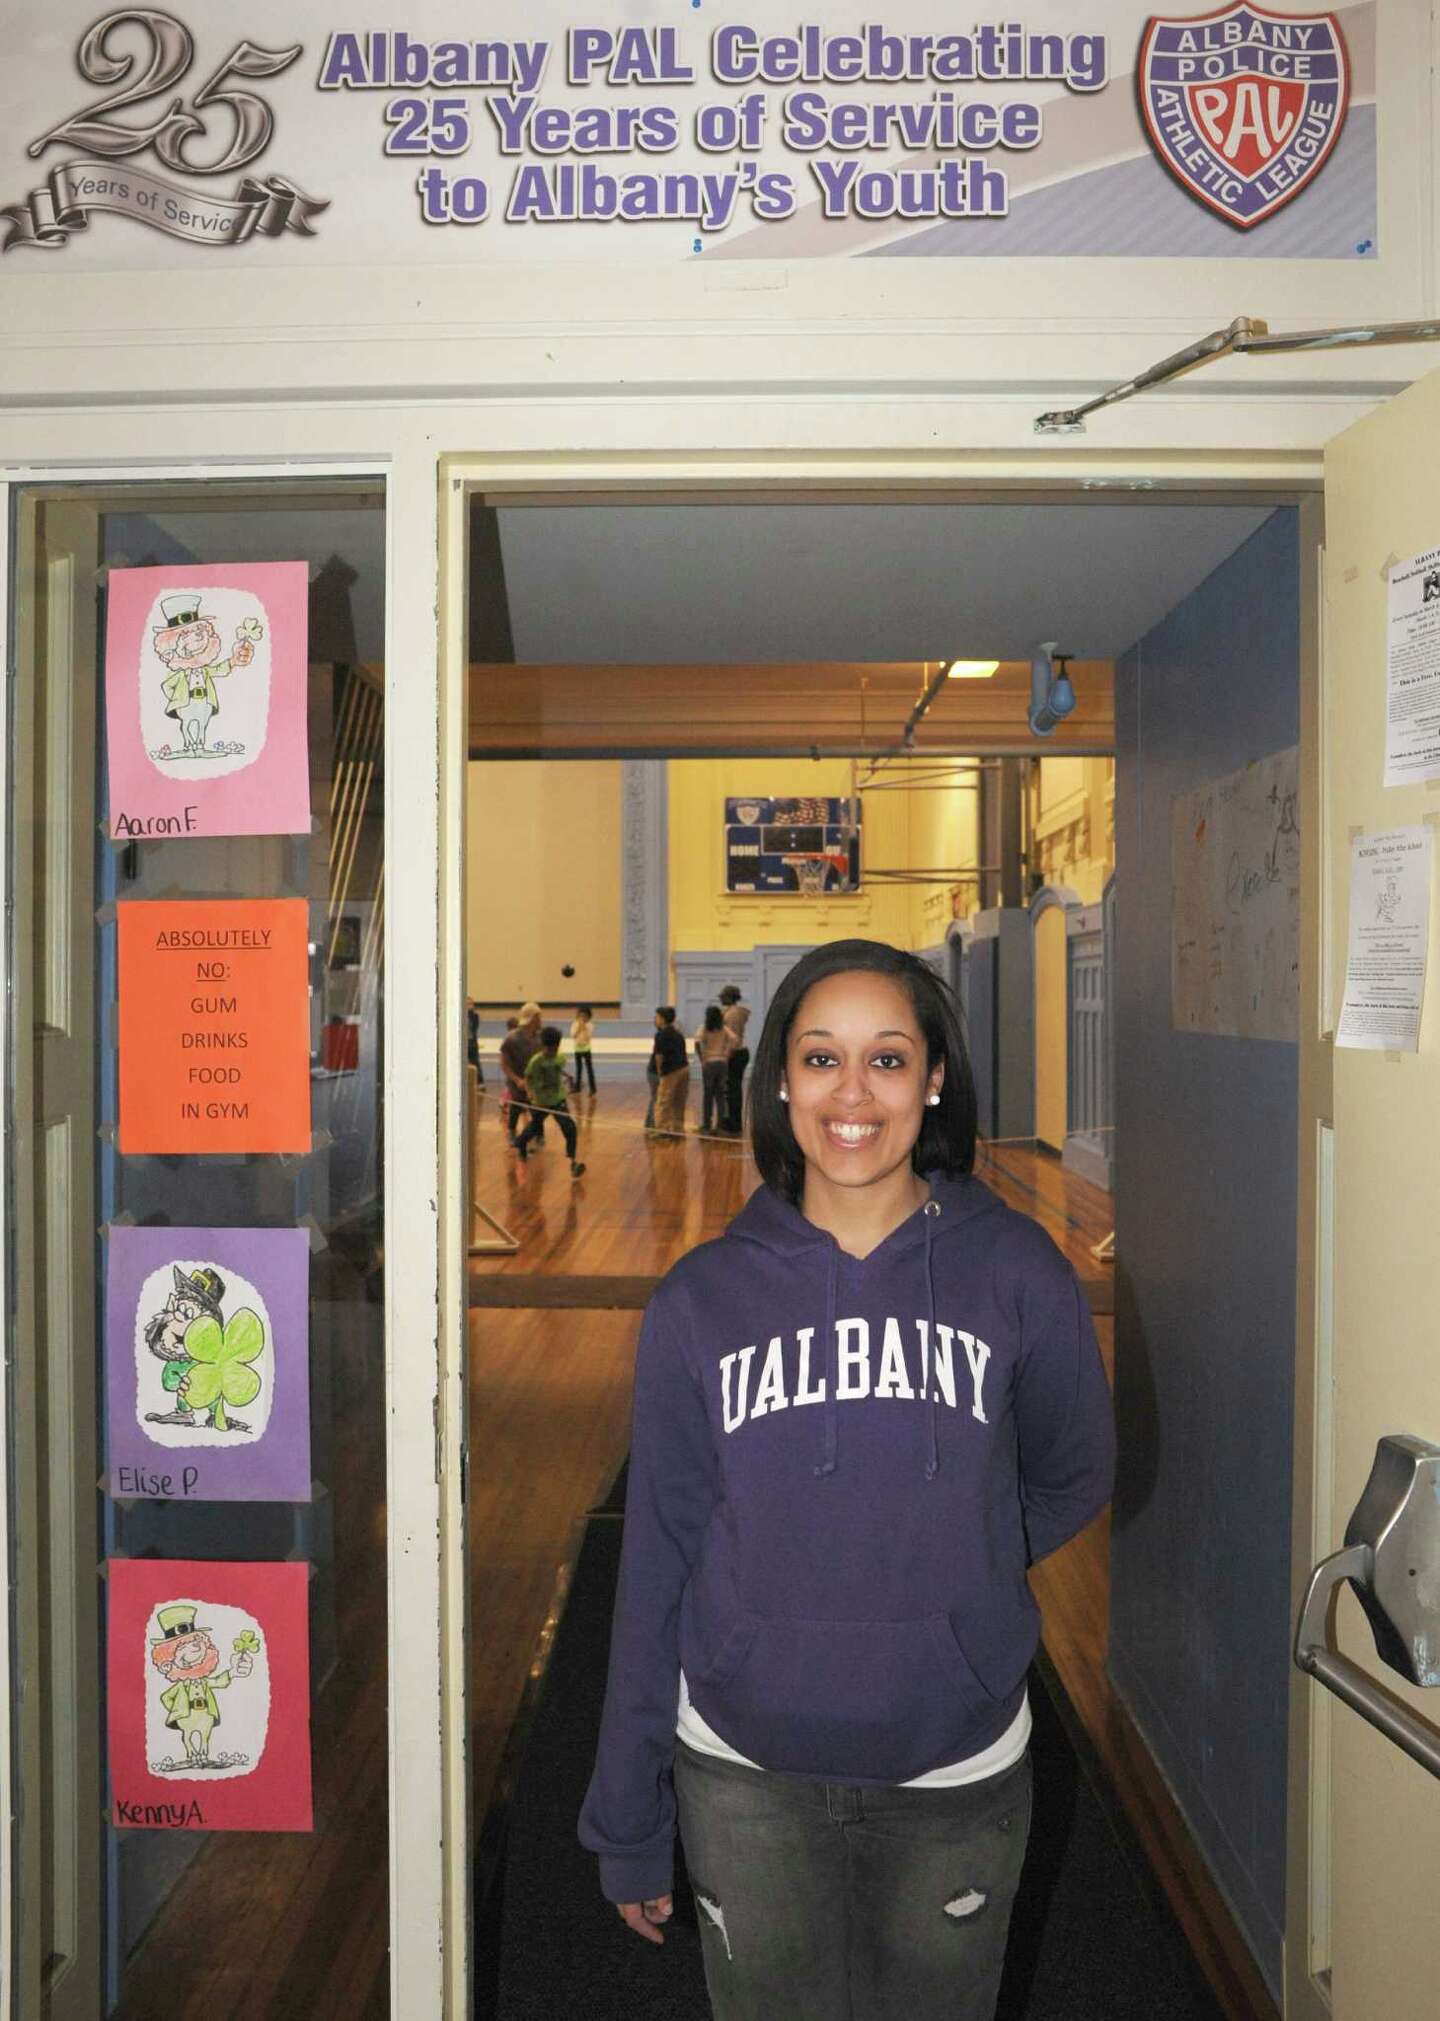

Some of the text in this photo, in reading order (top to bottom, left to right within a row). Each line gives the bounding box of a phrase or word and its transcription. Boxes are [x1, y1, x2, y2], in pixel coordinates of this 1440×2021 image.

[1177, 20, 1314, 52] ALBANY
[323, 23, 1106, 92] Albany PAL Celebrating
[1177, 49, 1312, 81] POLICE
[27, 9, 303, 175] 25
[389, 91, 1040, 151] 25 Years of Service
[1195, 83, 1294, 159] PAL
[1157, 88, 1244, 204] ATHLETIC
[1255, 100, 1334, 201] LEAGUE
[70, 176, 129, 198] Years
[136, 190, 159, 210] of
[422, 159, 1006, 226] to Albany's Youth
[115, 812, 181, 836] Aaron
[156, 929, 272, 947] ABSOLUTELY
[196, 962, 231, 979] NO:
[190, 997, 237, 1014] GUM
[181, 1033, 248, 1049] DRINKS
[189, 1068, 241, 1084] FOOD
[181, 1103, 249, 1119] IN GYM
[719, 1317, 991, 1434] UALBANY
[118, 1467, 175, 1494] Elise
